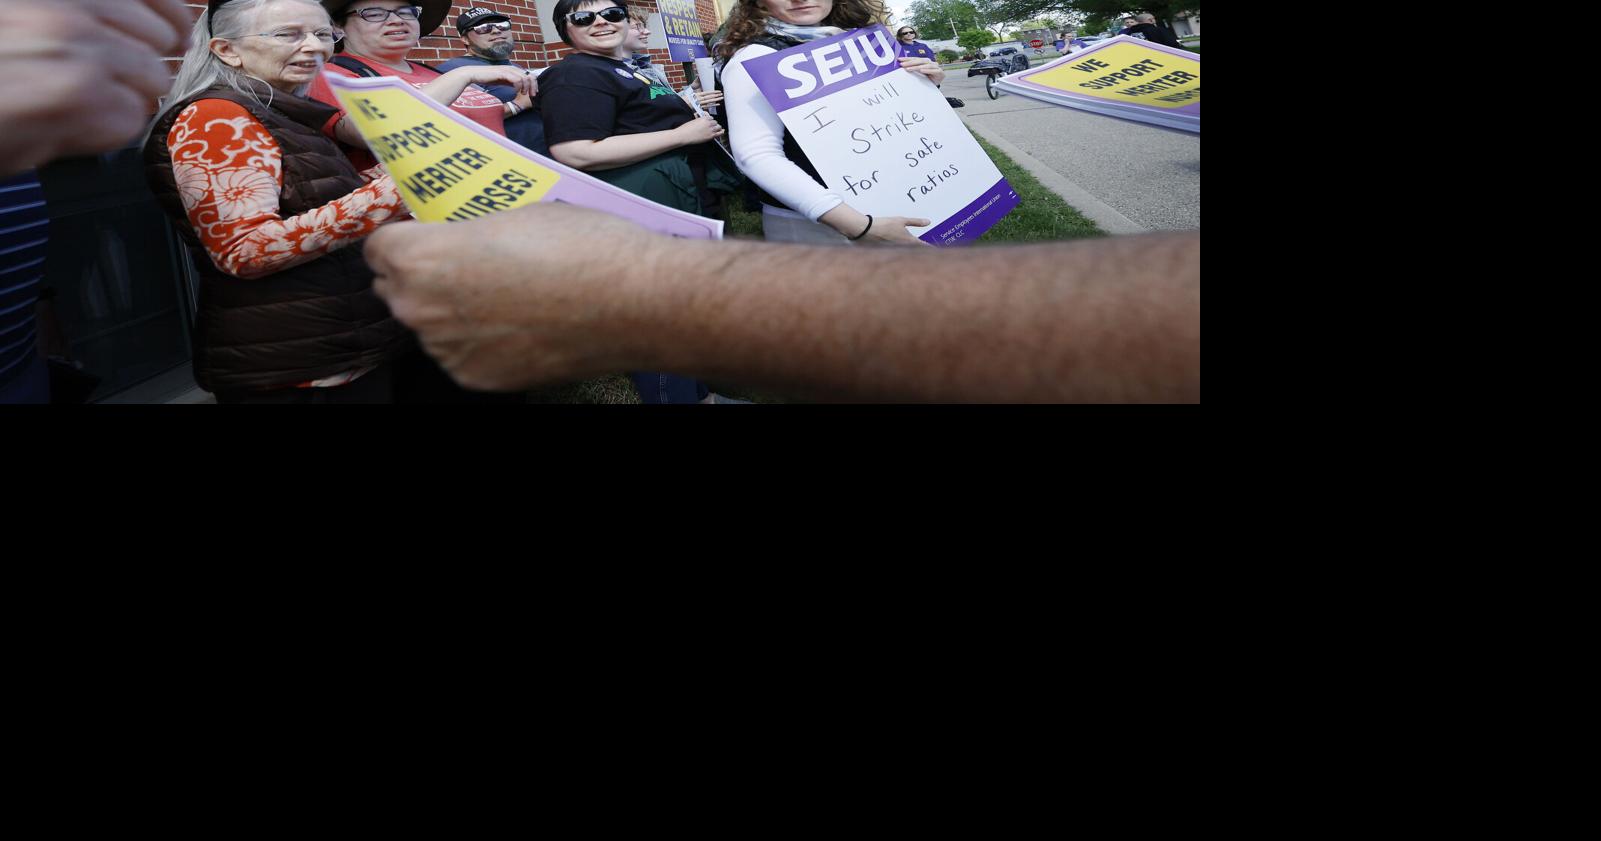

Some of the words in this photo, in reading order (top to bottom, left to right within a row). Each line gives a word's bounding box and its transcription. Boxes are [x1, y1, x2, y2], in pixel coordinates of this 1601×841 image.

[665, 16, 673, 35] &
[777, 30, 895, 99] SEIU
[1071, 58, 1110, 73] WE
[1079, 58, 1164, 90] SUPPORT
[1116, 70, 1199, 96] MERITER
[355, 98, 387, 120] WE
[803, 106, 836, 133] I
[862, 81, 901, 107] will
[371, 121, 451, 164] SUPPORT
[400, 147, 493, 205] MERITER
[842, 168, 880, 198] for
[904, 137, 943, 168] safe
[906, 161, 960, 203] ratios
[955, 215, 974, 230] Employees
